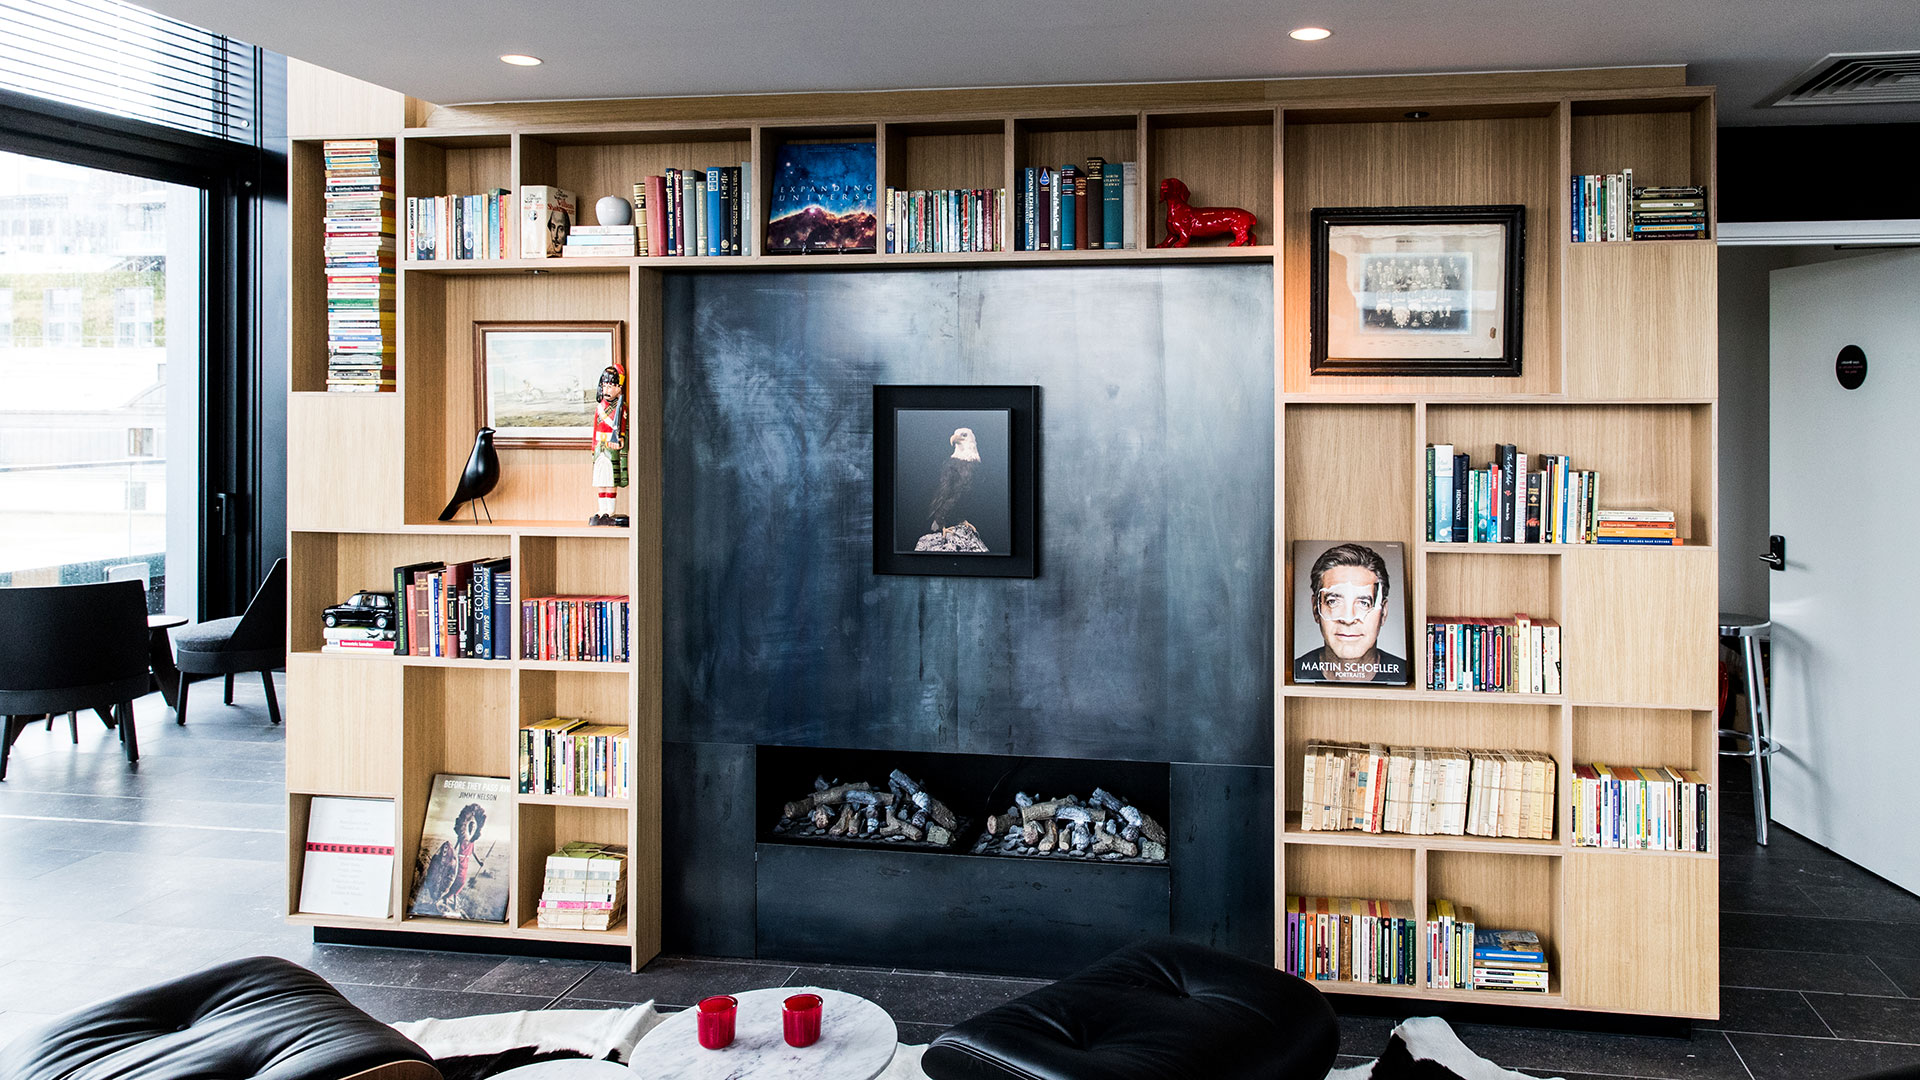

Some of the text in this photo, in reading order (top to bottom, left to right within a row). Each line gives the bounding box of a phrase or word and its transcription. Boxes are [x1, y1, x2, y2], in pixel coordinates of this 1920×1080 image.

[780, 184, 873, 193] EXPANDING
[778, 193, 873, 201] UNIVERSE
[474, 566, 484, 620] GEOLOGIE
[1301, 662, 1400, 673] MARTIN SCHOELLER
[444, 780, 466, 790] BEFORE
[467, 781, 482, 791] THEY
[483, 782, 499, 792] PASS
[459, 792, 498, 801] JIMMY NELSON
